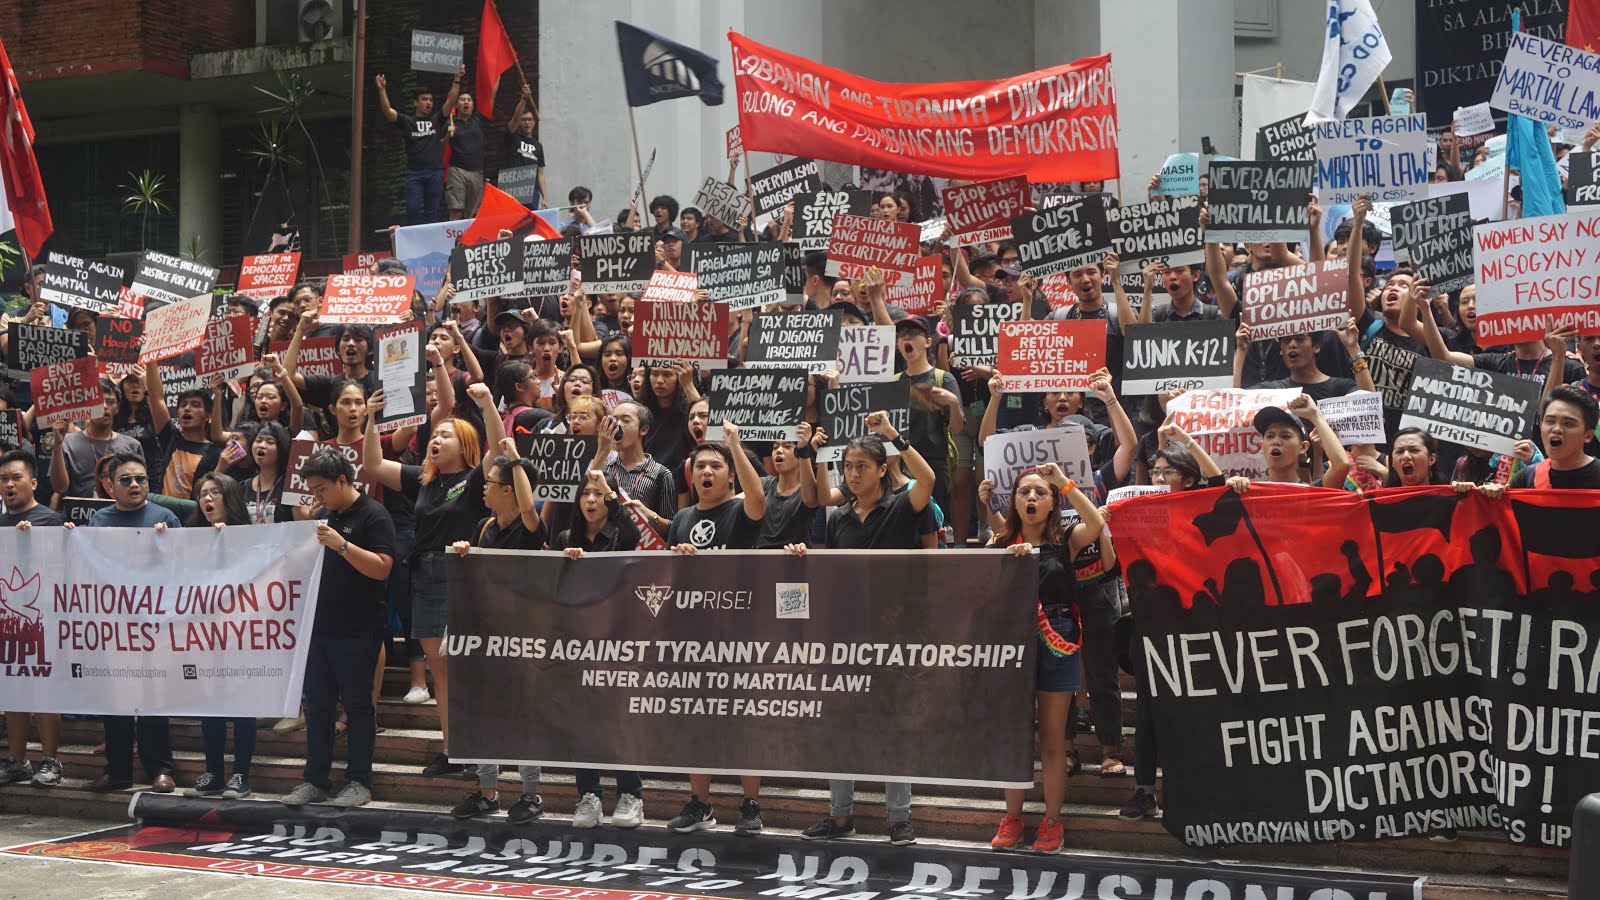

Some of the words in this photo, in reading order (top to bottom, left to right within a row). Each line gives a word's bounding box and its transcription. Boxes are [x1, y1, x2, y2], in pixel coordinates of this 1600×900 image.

[1444, 12, 1465, 31] SA
[1511, 33, 1573, 65] NEVER
[1545, 61, 1571, 79] TO
[734, 46, 830, 111] LABANAN
[840, 87, 873, 109] ANG
[1007, 62, 1118, 121] DIKTADURA
[1496, 65, 1565, 111] MARTIAL
[1508, 99, 1557, 121] BUKLOD
[1557, 115, 1585, 130] CSSP
[416, 121, 433, 132] UP
[801, 110, 848, 134] ANG
[851, 123, 975, 157] PAMBANSANG
[987, 114, 1119, 156] DEMOKRASYA
[1265, 118, 1302, 143] FIGHT
[1317, 119, 1364, 141] NEVER
[1371, 116, 1425, 136] AGAIN
[520, 141, 536, 153] UP
[1355, 138, 1383, 152] TO
[1210, 166, 1263, 190] NEVER
[1264, 166, 1312, 189] AGAIN
[1319, 154, 1386, 190] MARTIAL
[1389, 152, 1427, 189] LAW
[702, 176, 752, 215] RESIST
[814, 192, 850, 206] END
[947, 187, 987, 210] Stop
[1251, 189, 1268, 202] TO
[1031, 202, 1083, 233] OUST
[1105, 199, 1170, 223] IBASURA
[1208, 203, 1273, 225] MARTIAL
[1276, 205, 1310, 225] LAW
[1402, 197, 1451, 221] OUST
[834, 214, 895, 235] IBASURA
[1120, 212, 1180, 235] OPLAN
[832, 229, 857, 243] ANG
[957, 232, 983, 245] ALAY
[1110, 227, 1203, 255] TOKHANG!
[1477, 225, 1534, 252] WOMEN
[1539, 222, 1569, 243] SAY
[464, 242, 511, 263] DEFEND
[552, 242, 571, 255] ANG
[581, 236, 625, 259] HANDS
[628, 236, 651, 253] OFF
[830, 242, 894, 261] SECURITY
[894, 250, 918, 267] ACT!
[49, 251, 84, 269] NEVER
[88, 261, 124, 279] AGAIN
[145, 251, 179, 269] JUSTICE
[179, 260, 193, 272] FOR
[242, 264, 295, 276] DEMOCRATIC
[254, 255, 277, 265] FIGHT
[357, 254, 375, 267] END
[467, 257, 507, 279] PRESS
[596, 257, 638, 279] PH!!
[698, 250, 752, 273] IPAGLABAN
[756, 248, 780, 264] ANG
[1481, 247, 1587, 285] MISOGYNY
[75, 269, 89, 280] TO
[141, 266, 172, 282] JUSTICE
[170, 273, 187, 286] FOR
[187, 277, 209, 294] ALL!
[251, 274, 290, 286] SPACES!
[331, 275, 407, 289] SERBISYO
[456, 271, 515, 292] FREEDOM!
[757, 264, 772, 279] SA
[917, 265, 936, 280] LAW
[1245, 262, 1316, 288] IBASURA
[1322, 257, 1348, 272] ANG
[45, 273, 91, 294] MARTIAL
[95, 287, 120, 300] LAW
[353, 287, 374, 296] TAO
[1245, 276, 1318, 304] OPLAN
[327, 303, 401, 315] NEGOSYO!
[328, 295, 362, 304] HUWAG
[364, 295, 407, 304] GAWING
[1245, 290, 1347, 323] TOKHANG!
[652, 302, 700, 322] MILITAR
[701, 303, 717, 322] SA
[759, 313, 782, 329] TAX
[786, 313, 833, 329] REFORM
[972, 303, 1024, 319] STOP
[18, 325, 81, 347] DUTERTE
[109, 320, 133, 333] NO
[208, 320, 233, 340] END
[1480, 313, 1546, 337] DILIMAN
[203, 335, 236, 358] STATE
[647, 338, 720, 358] PALAYASIN!
[760, 331, 775, 344] NI
[778, 329, 824, 345] DIGONG
[1019, 336, 1074, 348] RETURN
[19, 340, 76, 358] PASISTA
[140, 350, 158, 363] ALAY
[766, 345, 817, 359] IBASURA!
[1011, 348, 1065, 361] SERVICE
[1126, 338, 1182, 370] JUNK
[1185, 337, 1228, 366] K-12!
[48, 362, 75, 379] END
[201, 348, 247, 373] FASCISM
[1030, 360, 1088, 373] SYSTEM!
[42, 373, 81, 393] STATE
[228, 369, 239, 380] UP
[710, 375, 774, 392] IPAGLABAN
[777, 376, 805, 392] ANG
[1034, 377, 1092, 389] EDUCATION
[1451, 364, 1494, 389] END
[37, 386, 99, 411] FASCISM!
[725, 392, 782, 407] NATIONAL
[825, 386, 872, 415] OUST
[1190, 391, 1247, 410] FIGHT
[1352, 397, 1380, 406] MARCOS
[1407, 395, 1428, 413] IN
[1411, 375, 1482, 404] MARTIAL
[1485, 390, 1528, 413] LAW
[708, 408, 755, 425] MINIMUM
[1359, 415, 1380, 423] TUTA
[1427, 423, 1488, 447] UPRISE
[530, 437, 556, 458] NO
[563, 437, 586, 460] TO
[1003, 439, 1061, 464] OUST
[538, 485, 571, 500] OSR
[53, 583, 166, 615] NATIONAL
[174, 581, 259, 615] UNION
[266, 580, 302, 612] OF
[675, 590, 753, 610] UPRISE!
[168, 618, 297, 652] LAWYERS
[447, 635, 482, 656] UP
[485, 635, 547, 659] RISES
[550, 639, 650, 661] AGAINST
[655, 640, 771, 663] TYRANNY
[772, 642, 826, 664] AND
[831, 642, 1025, 668] DICTATORSHIP!
[1142, 626, 1330, 698] NEVER
[1337, 607, 1532, 686] FORGET!
[5, 665, 52, 678] LAW
[581, 669, 640, 688] NEVER
[642, 671, 701, 689] AGAIN
[705, 672, 729, 689] TO
[732, 672, 817, 691] MARTIAL
[820, 673, 872, 693] LAW!
[628, 696, 667, 714] END
[669, 697, 728, 716] STATE
[732, 698, 823, 718] FASCISM!
[1220, 713, 1326, 767] FIGHT
[1348, 695, 1493, 757] AGAINST
[1375, 804, 1501, 839] ALAYSINING
[241, 823, 345, 846] NO
[754, 854, 870, 885] NO
[186, 842, 398, 865] NEVER
[401, 859, 630, 883] AGAIN
[646, 876, 744, 891] TO
[206, 860, 524, 896] UNIVERSITY
[531, 884, 607, 899] OF
